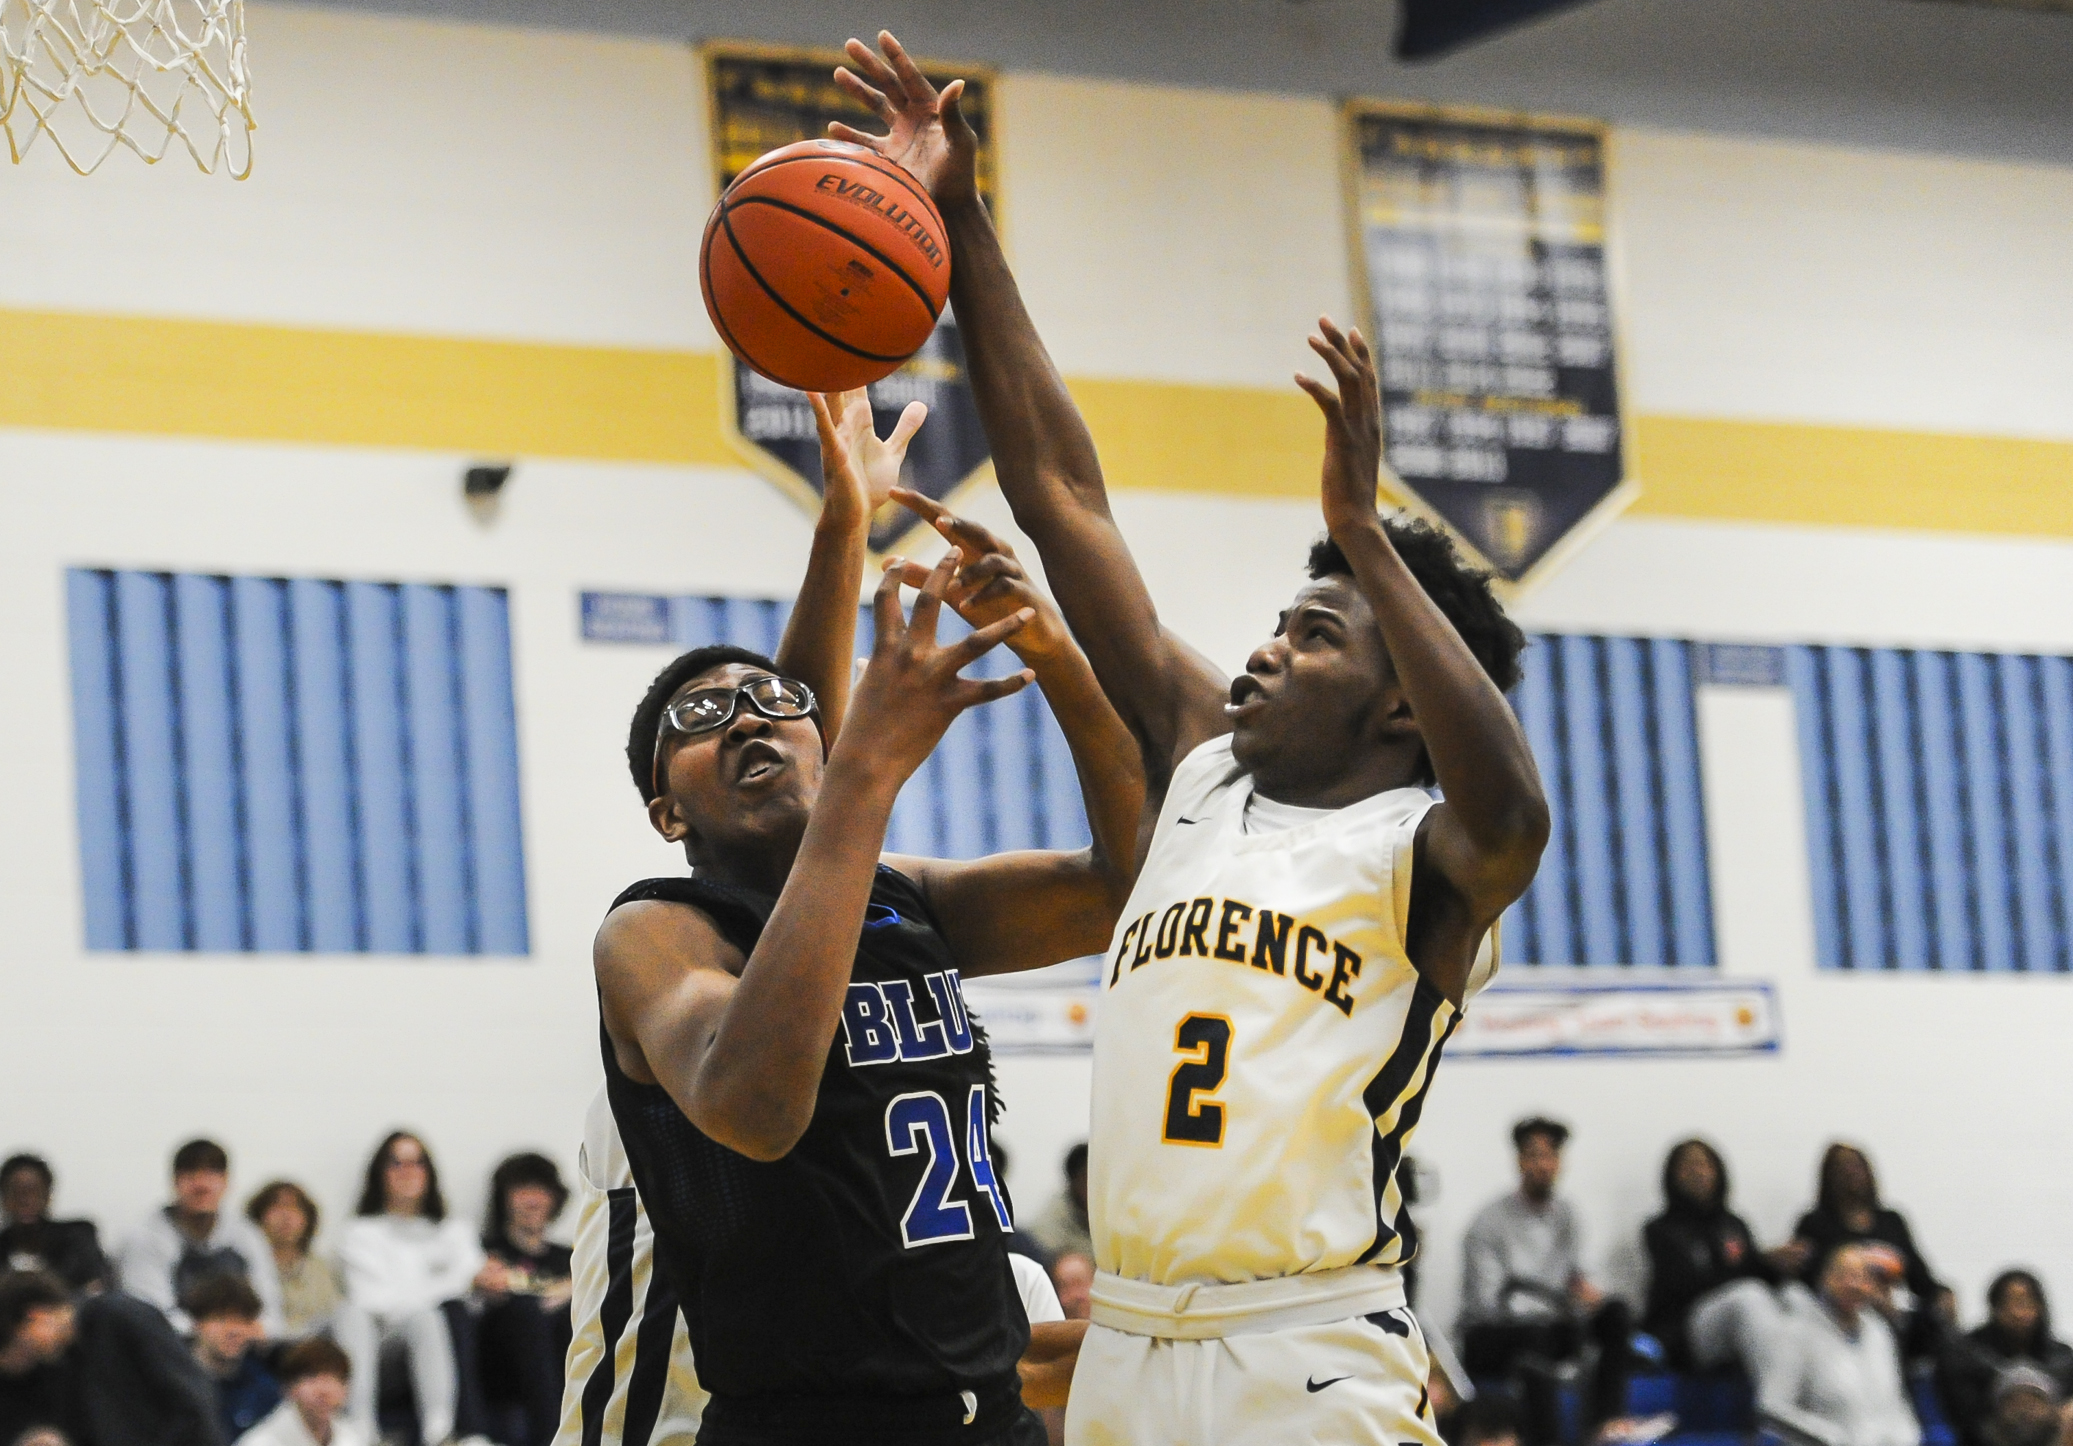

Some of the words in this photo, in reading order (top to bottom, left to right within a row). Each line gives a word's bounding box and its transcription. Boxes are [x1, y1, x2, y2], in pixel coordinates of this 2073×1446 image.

[815, 174, 944, 269] EVOLUTION
[1108, 897, 1363, 1018] FLORENCE
[1161, 1011, 1236, 1149] 2
[885, 1084, 1015, 1249] 24
